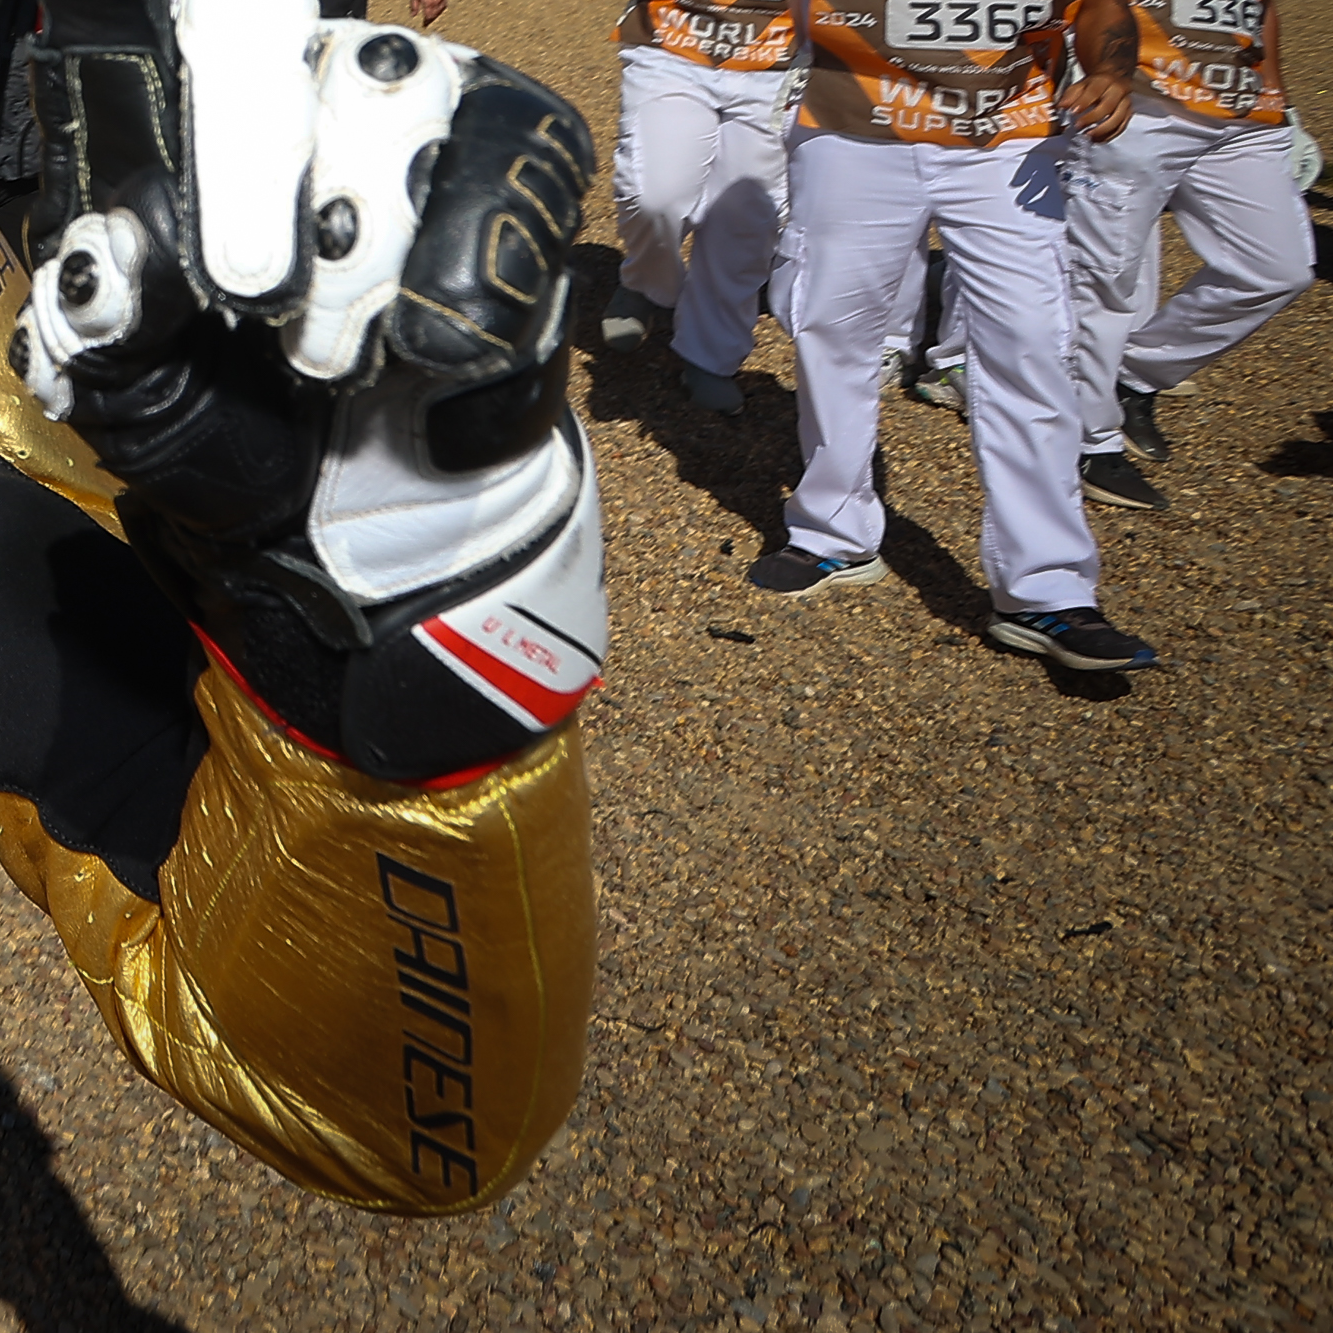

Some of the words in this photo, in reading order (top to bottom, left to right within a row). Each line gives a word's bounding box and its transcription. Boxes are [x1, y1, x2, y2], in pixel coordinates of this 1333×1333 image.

[656, 5, 795, 47] WORLD
[814, 10, 878, 28] 2024
[651, 28, 791, 63] SUPERBIKE
[870, 103, 1059, 138] SUPERBIKE
[376, 850, 478, 1196] DAINESE
